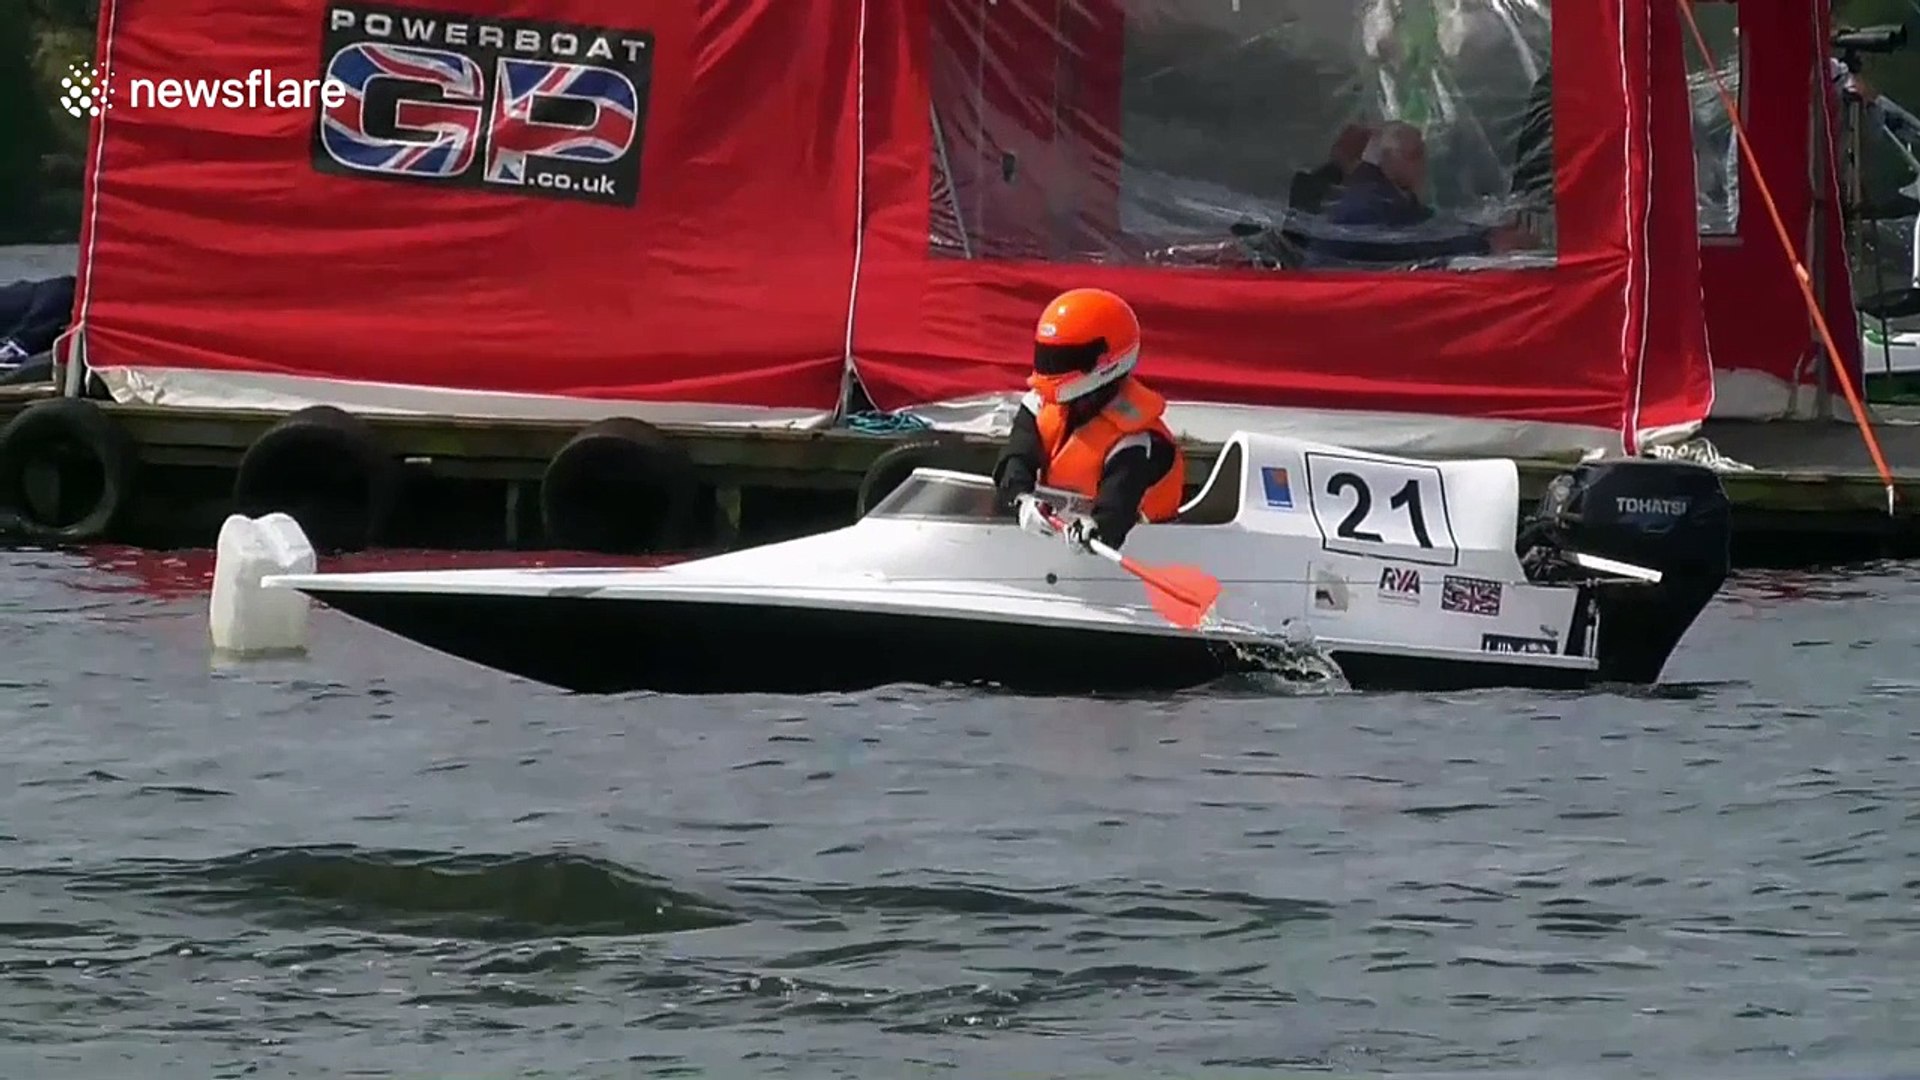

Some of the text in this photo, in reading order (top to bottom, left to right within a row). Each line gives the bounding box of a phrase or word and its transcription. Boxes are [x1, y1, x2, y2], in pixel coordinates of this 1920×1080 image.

[330, 9, 646, 62] POWERBOAT
[320, 42, 638, 185] GP
[528, 171, 616, 195] .co.uk
[1327, 472, 1433, 549] 21
[1380, 567, 1420, 594] RYA
